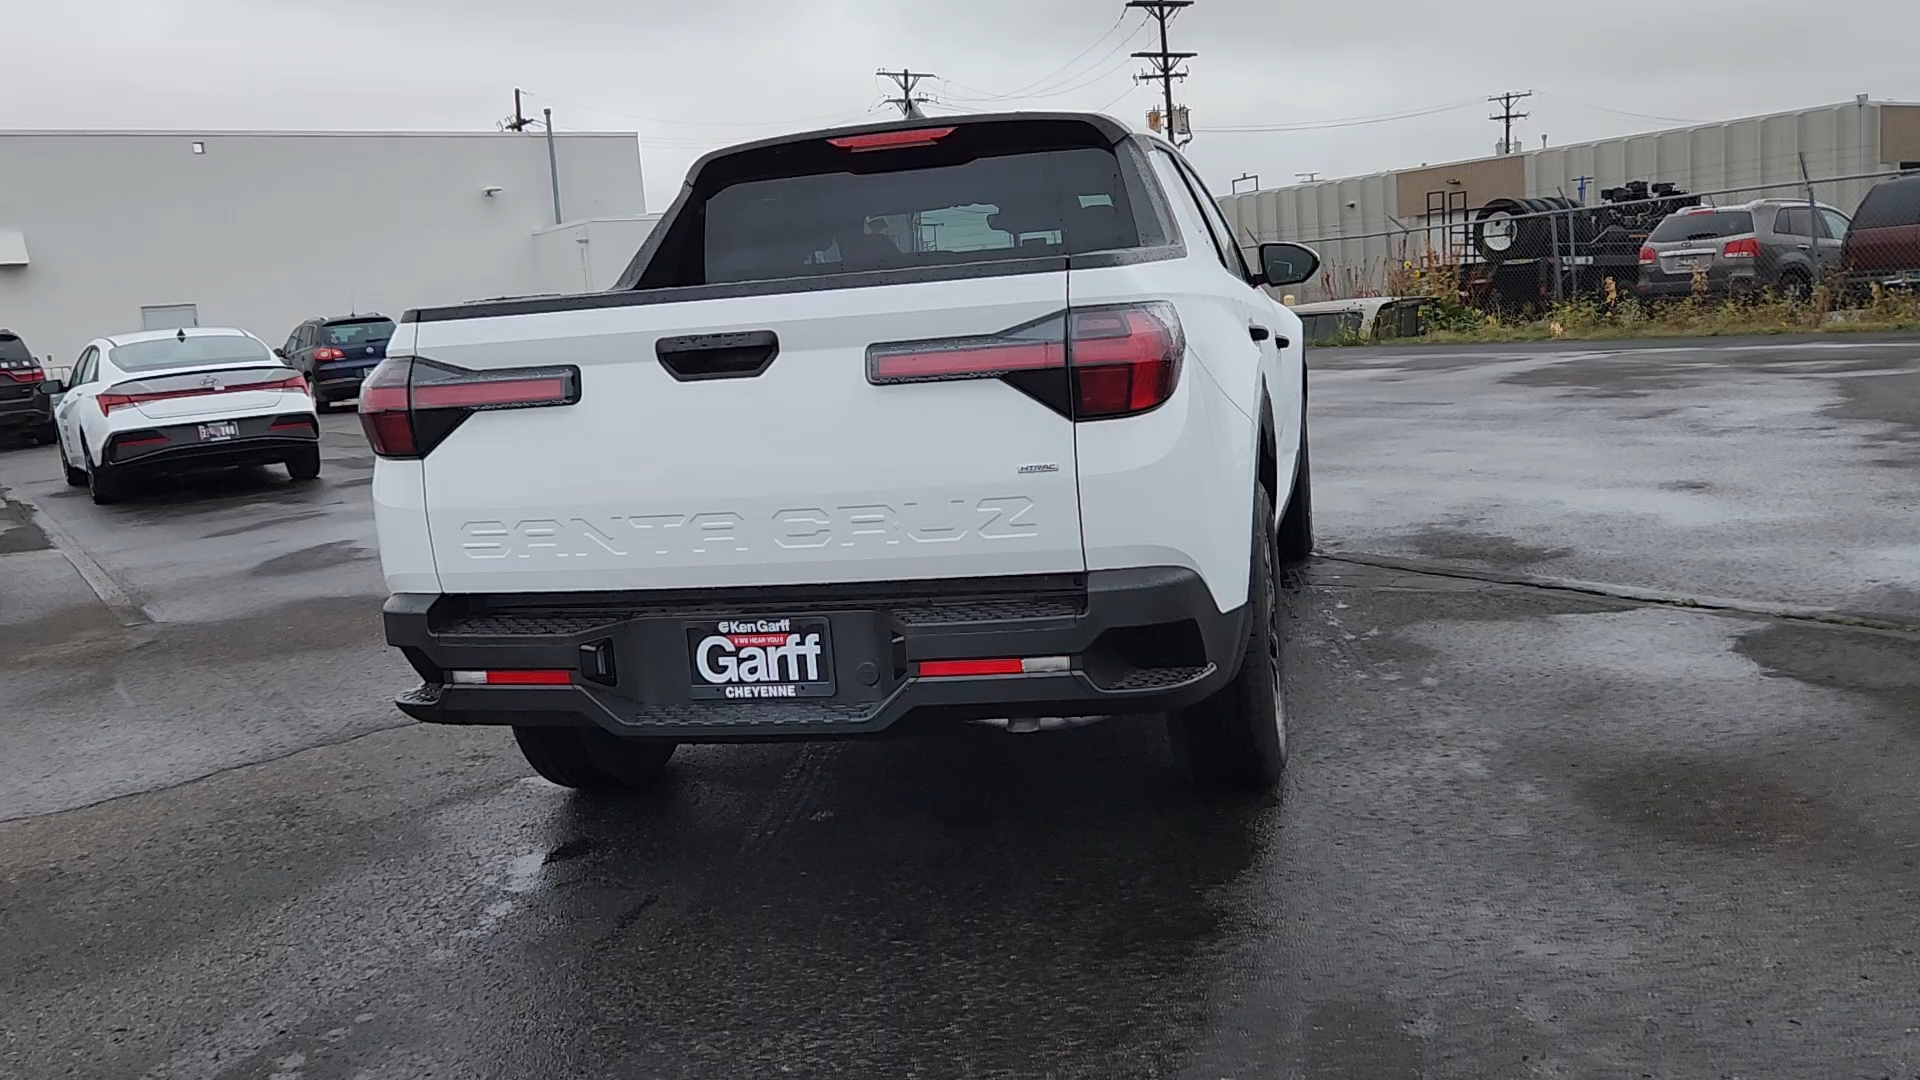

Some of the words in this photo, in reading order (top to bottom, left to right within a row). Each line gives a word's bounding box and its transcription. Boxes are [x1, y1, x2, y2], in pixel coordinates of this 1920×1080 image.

[1020, 463, 1057, 472] HTRAC
[461, 512, 749, 560] SANTA
[771, 496, 1038, 549] CRUZ
[730, 621, 756, 633] Ken
[757, 619, 790, 632] Garff
[696, 633, 821, 683] Garff
[725, 685, 796, 698] CHEYENNE
